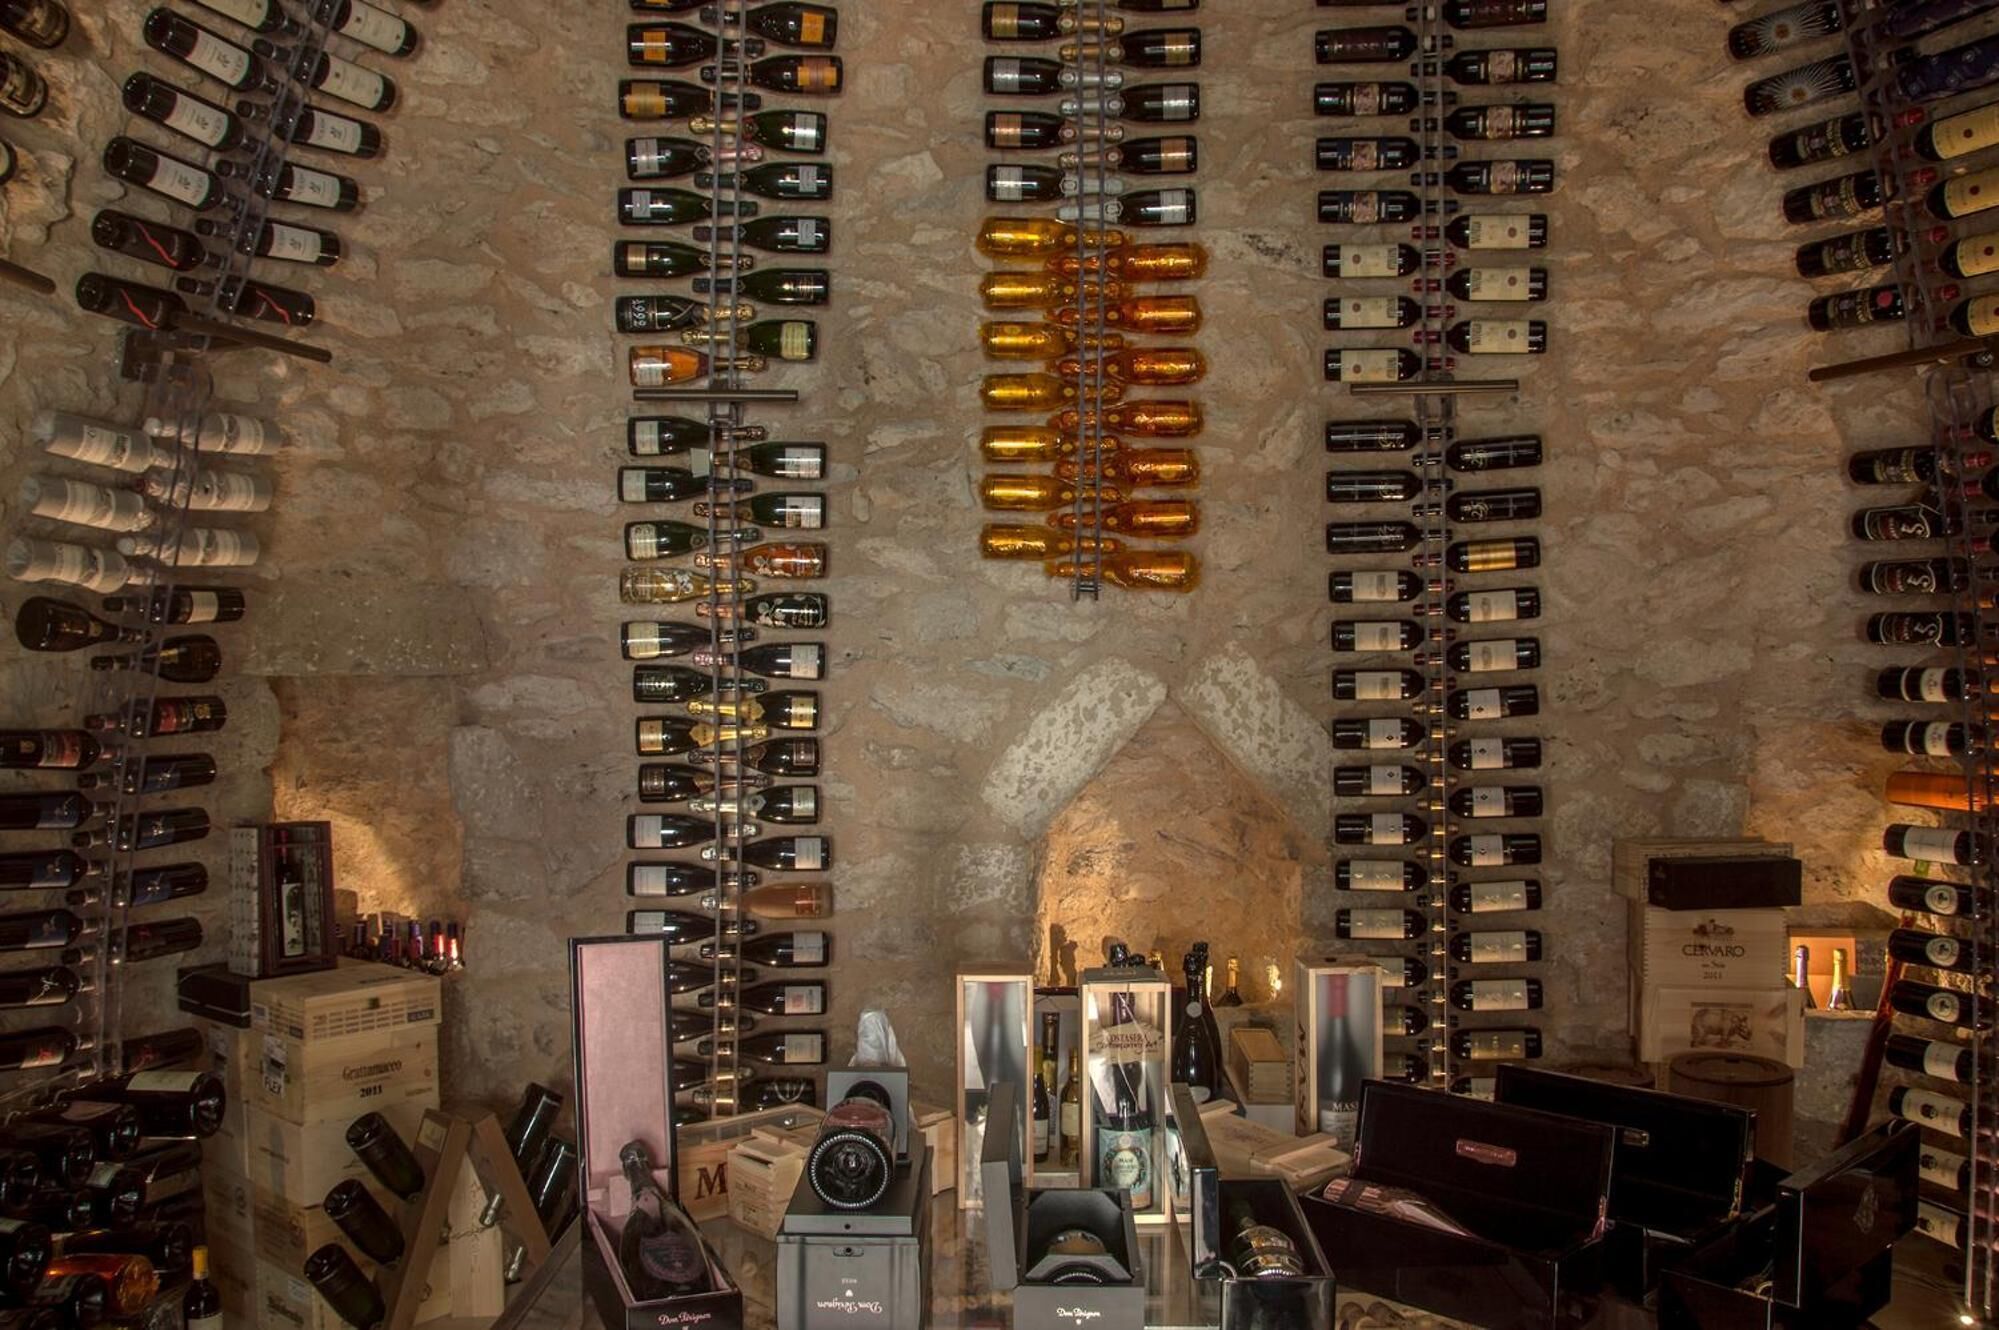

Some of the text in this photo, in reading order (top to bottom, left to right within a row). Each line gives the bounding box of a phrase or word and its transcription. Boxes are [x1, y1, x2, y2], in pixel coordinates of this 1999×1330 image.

[1682, 944, 1745, 957] CERVARO
[360, 1084, 383, 1098] 2011
[857, 1301, 883, 1314] Dom
[658, 1314, 679, 1325] Dom
